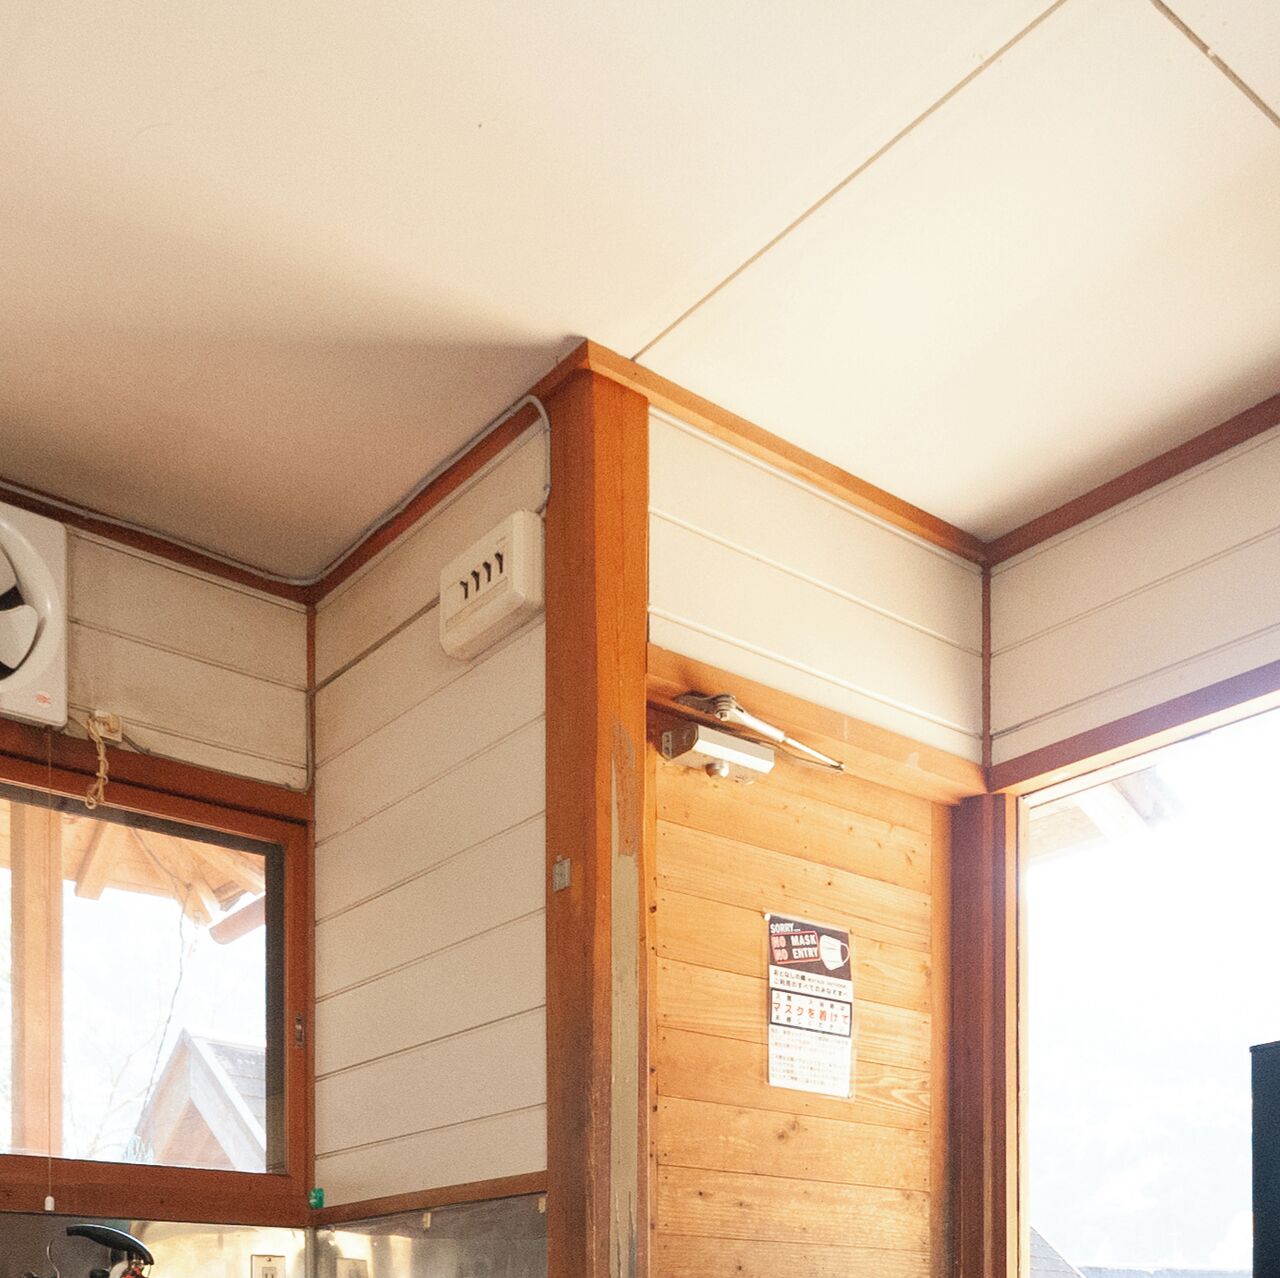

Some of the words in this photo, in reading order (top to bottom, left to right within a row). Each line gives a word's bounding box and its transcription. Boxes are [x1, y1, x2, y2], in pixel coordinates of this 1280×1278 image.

[771, 936, 787, 948] NO
[791, 935, 817, 946] MASK
[773, 949, 788, 961] NO
[791, 947, 819, 959] ENTRY
[772, 1002, 850, 1026] マスクを着けて
